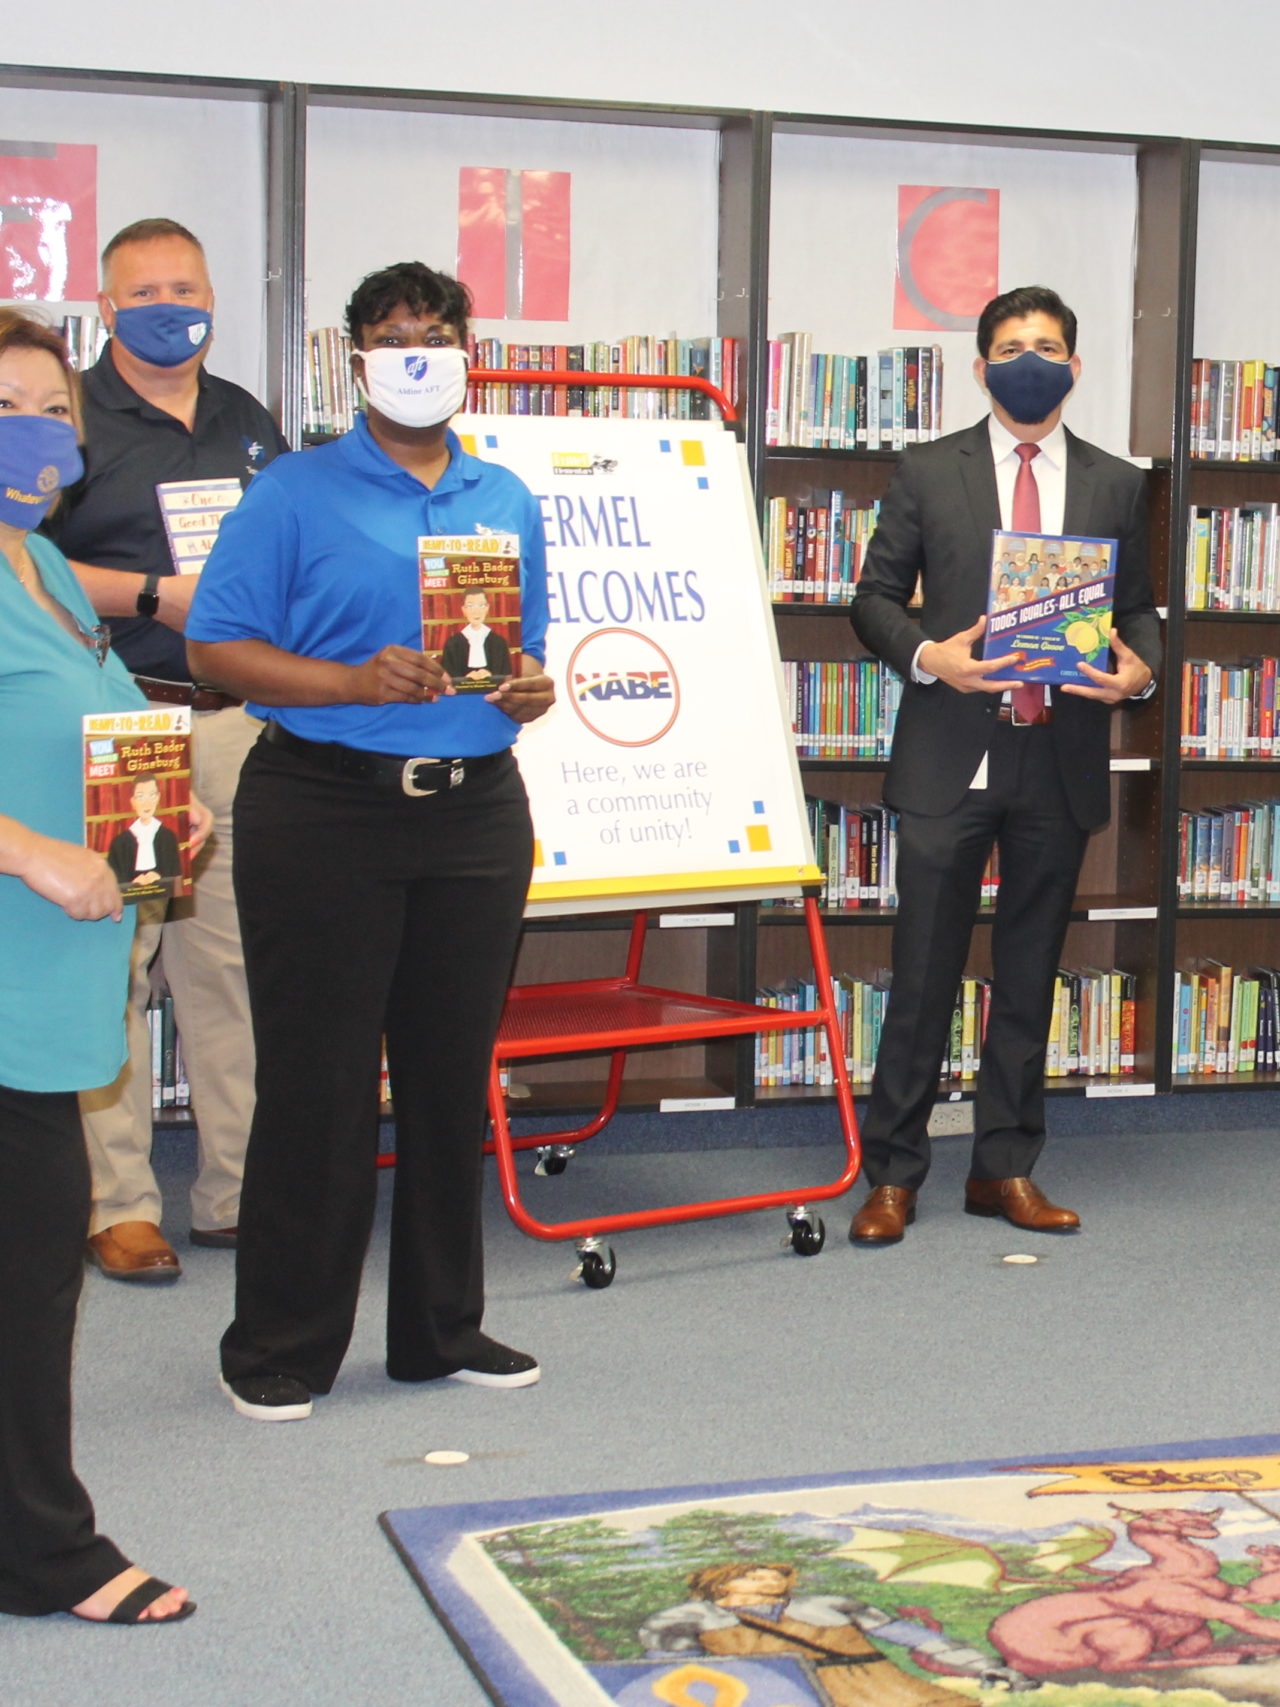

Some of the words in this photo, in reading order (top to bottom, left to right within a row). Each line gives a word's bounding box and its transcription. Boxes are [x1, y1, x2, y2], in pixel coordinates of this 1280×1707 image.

[897, 187, 989, 330] C
[397, 387, 422, 395] Aldine
[424, 385, 440, 393] AFT
[191, 493, 213, 506] One
[452, 562, 480, 573] Ruth
[482, 561, 515, 573] Bader
[424, 578, 447, 587] MEET
[458, 574, 510, 586] Ginsburg
[547, 570, 705, 624] ELCOMES
[990, 611, 1018, 634] TODOS
[1019, 599, 1056, 624] IGUALES
[1059, 592, 1075, 610] ALL
[1078, 582, 1107, 605] EQUAL
[574, 671, 672, 701] NABE
[121, 743, 152, 758] Ruth
[153, 740, 186, 754] Bader
[89, 764, 116, 777] MEET
[127, 756, 181, 771] Ginsburg
[561, 761, 626, 786] Here,
[633, 762, 665, 780] we
[674, 761, 708, 778] are
[567, 798, 579, 815] a
[587, 786, 712, 816] community
[600, 819, 621, 845] of
[630, 817, 692, 848] unity!
[1101, 1466, 1262, 1487] Step
